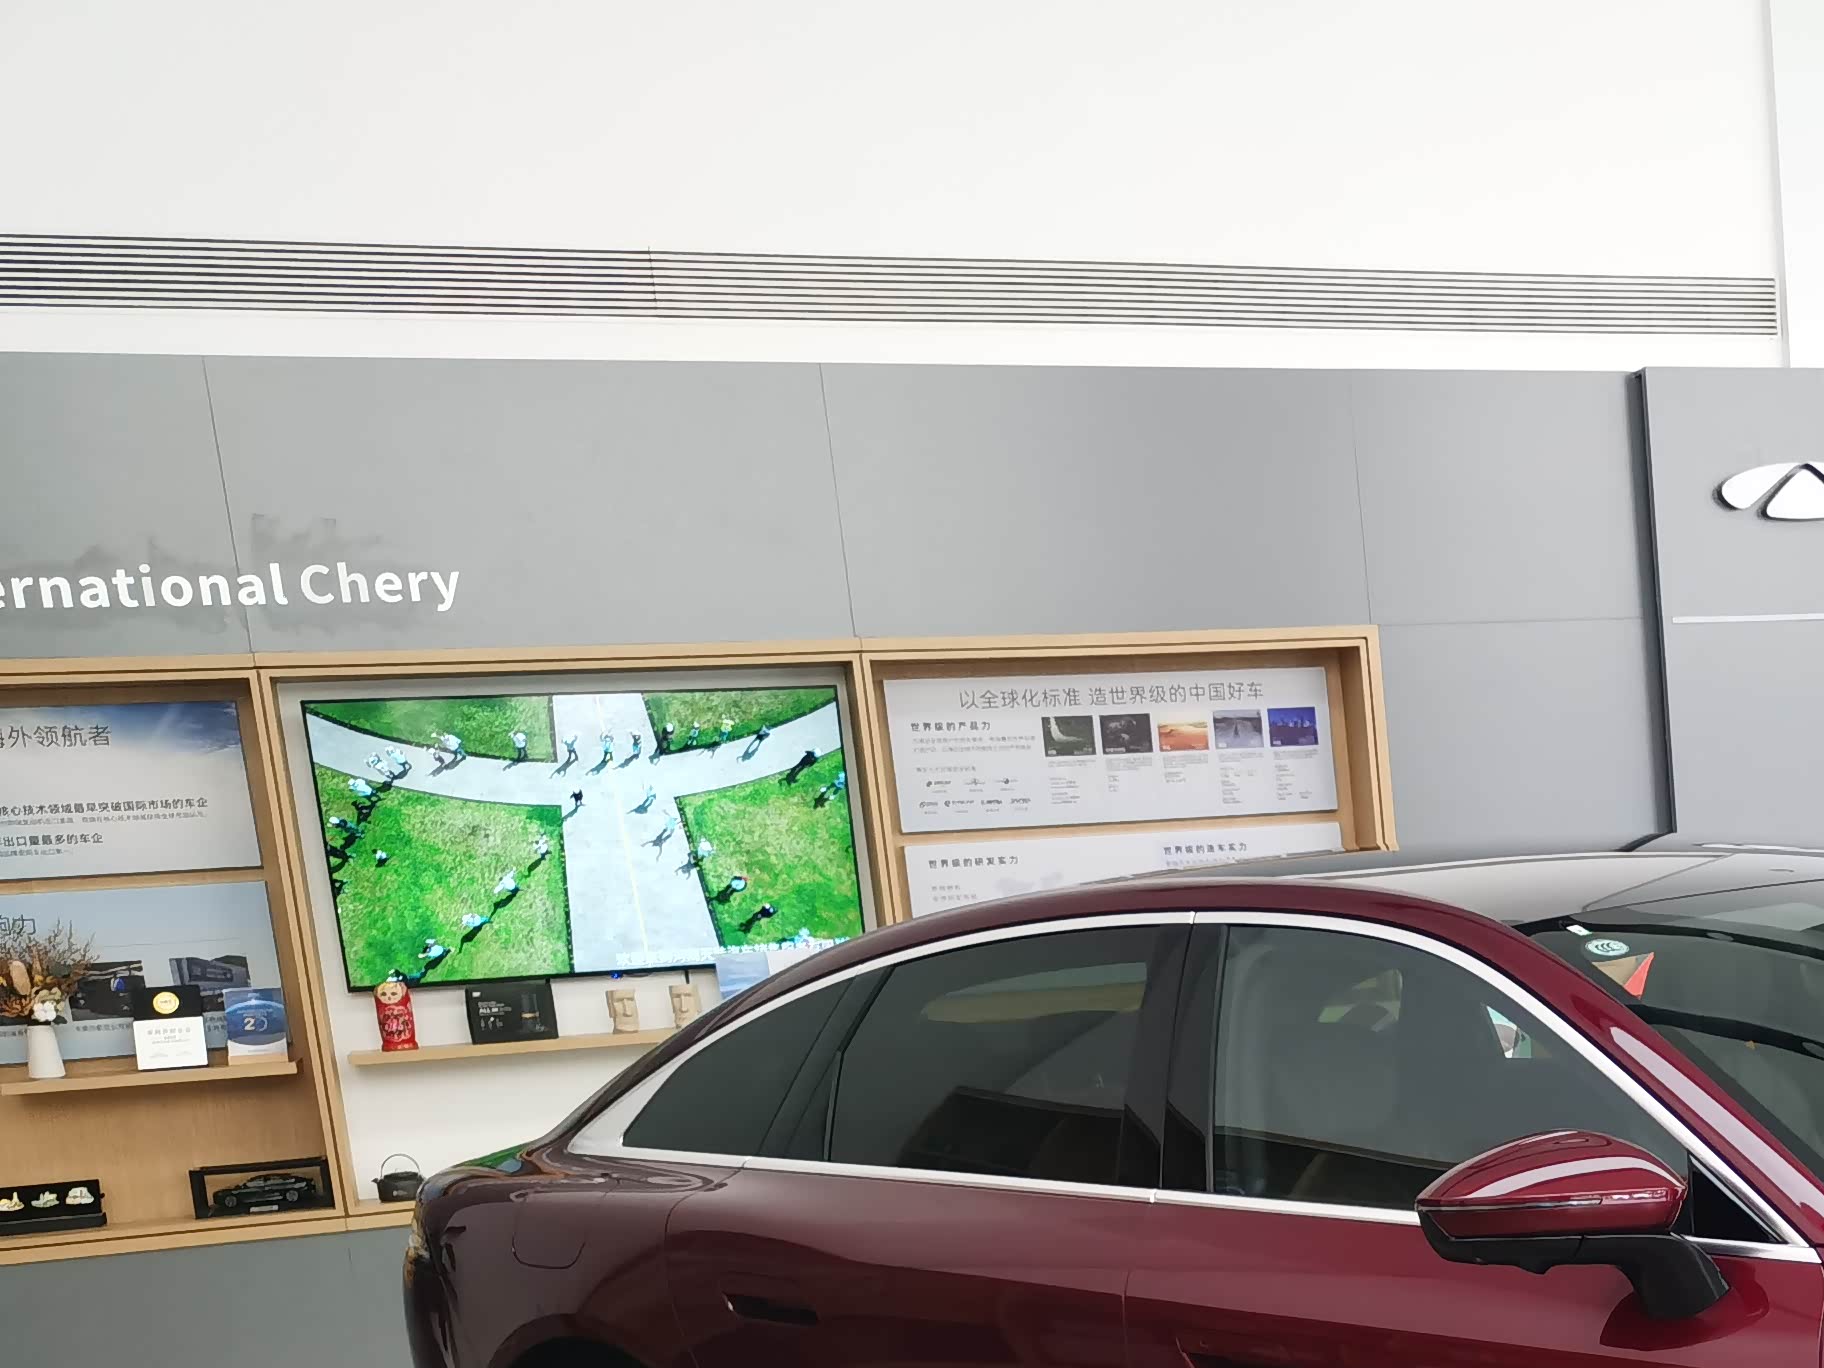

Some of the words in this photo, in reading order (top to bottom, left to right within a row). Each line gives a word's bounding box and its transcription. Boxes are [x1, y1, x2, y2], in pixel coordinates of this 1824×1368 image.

[0, 562, 289, 609] rnational
[300, 561, 460, 612] Chery
[959, 687, 1082, 709] 以全球化标准
[1088, 681, 1264, 706] 造世界级的中国好车
[0, 724, 112, 749] 外领航者
[0, 832, 104, 848] 出口量最多的车企
